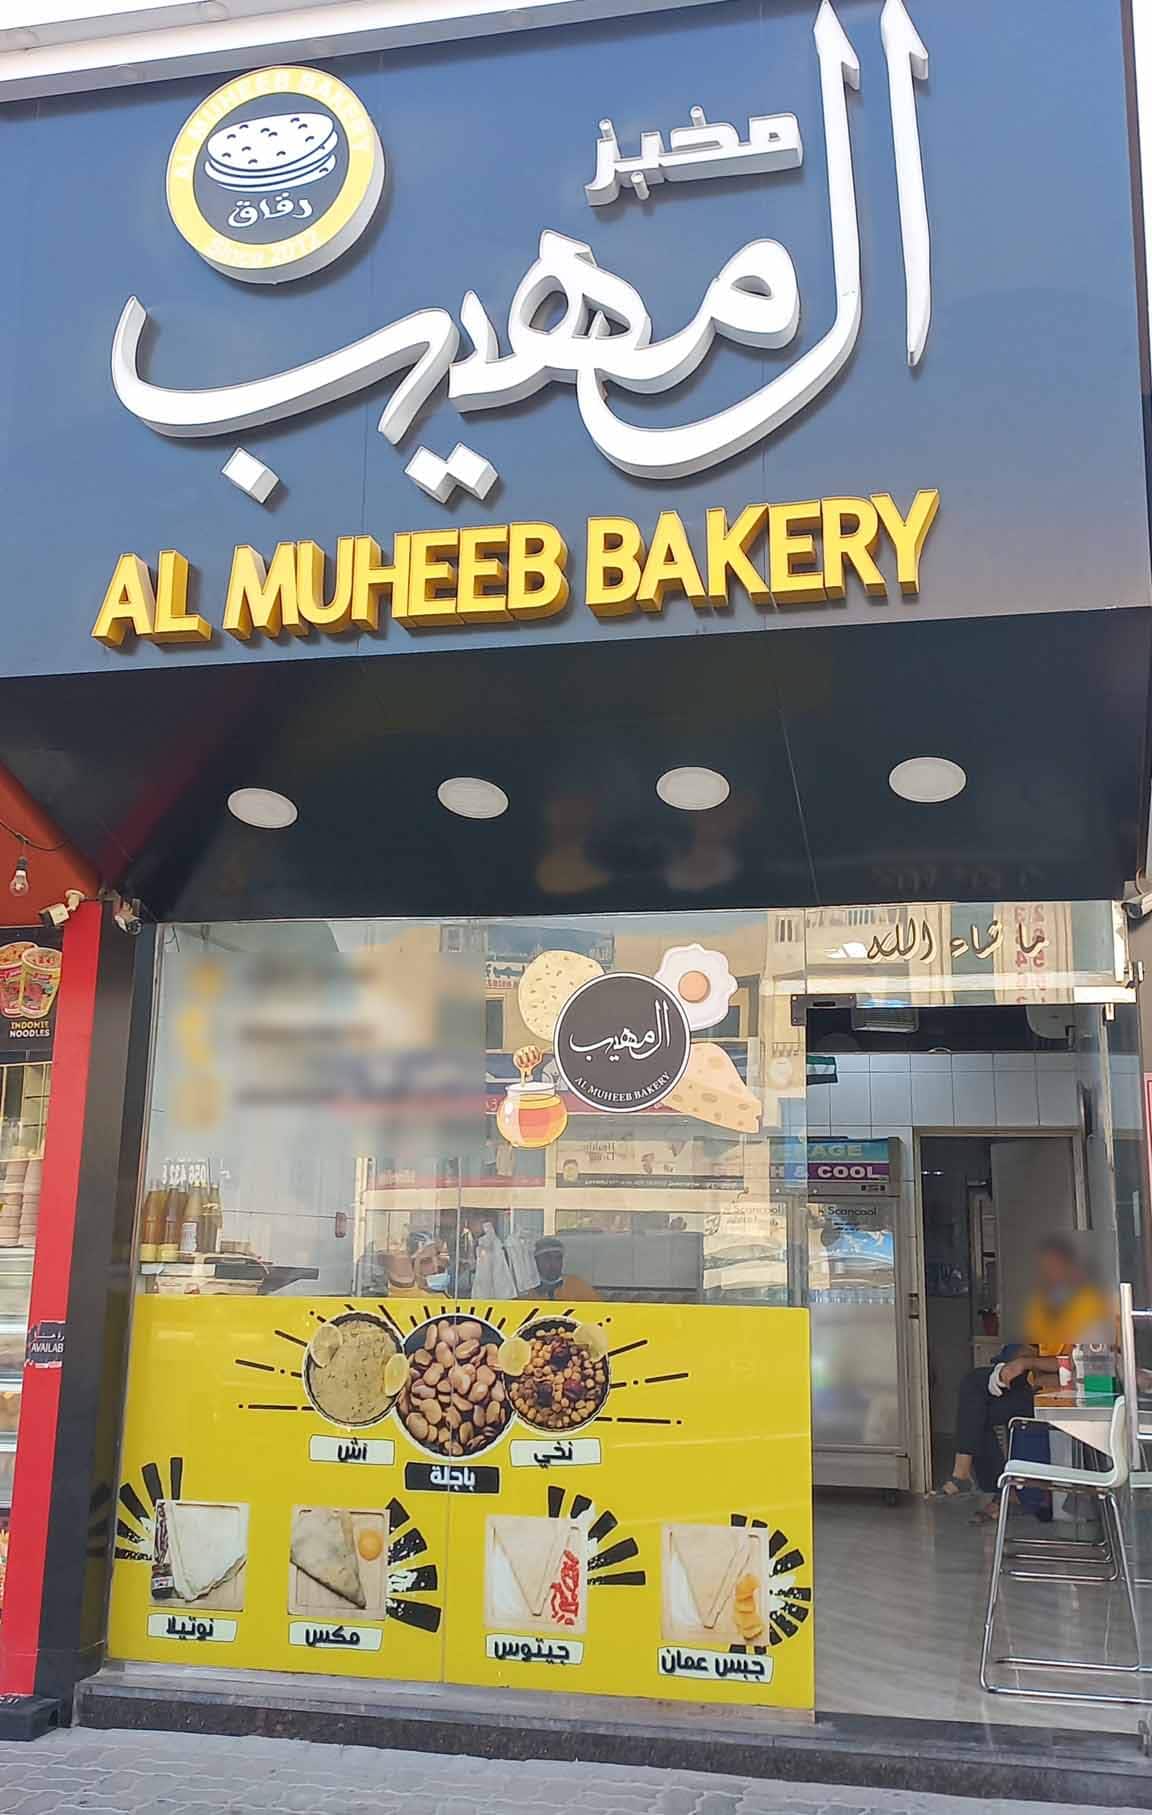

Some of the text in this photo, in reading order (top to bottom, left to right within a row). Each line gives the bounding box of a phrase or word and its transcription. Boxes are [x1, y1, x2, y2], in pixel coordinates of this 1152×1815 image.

[585, 105, 803, 207] مخبز
[227, 191, 314, 229] رقاق
[111, 0, 931, 503] المهيب
[92, 488, 940, 650] AL MUHEEB BAKERY
[867, 917, 937, 965] الله
[1018, 921, 1049, 957] ما
[9, 1029, 50, 1039] NOODLES
[569, 999, 671, 1062] المهيب
[574, 1071, 671, 1102] AL MUHEEB BAKERY
[817, 1165, 889, 1179] COOL
[533, 1441, 574, 1469] نخي
[430, 1465, 476, 1492] باجلة
[166, 1615, 215, 1641] نوتيلا
[305, 1625, 361, 1647] مكس
[494, 1637, 571, 1665] جيتوس
[661, 1648, 766, 1681] جبس عمان
